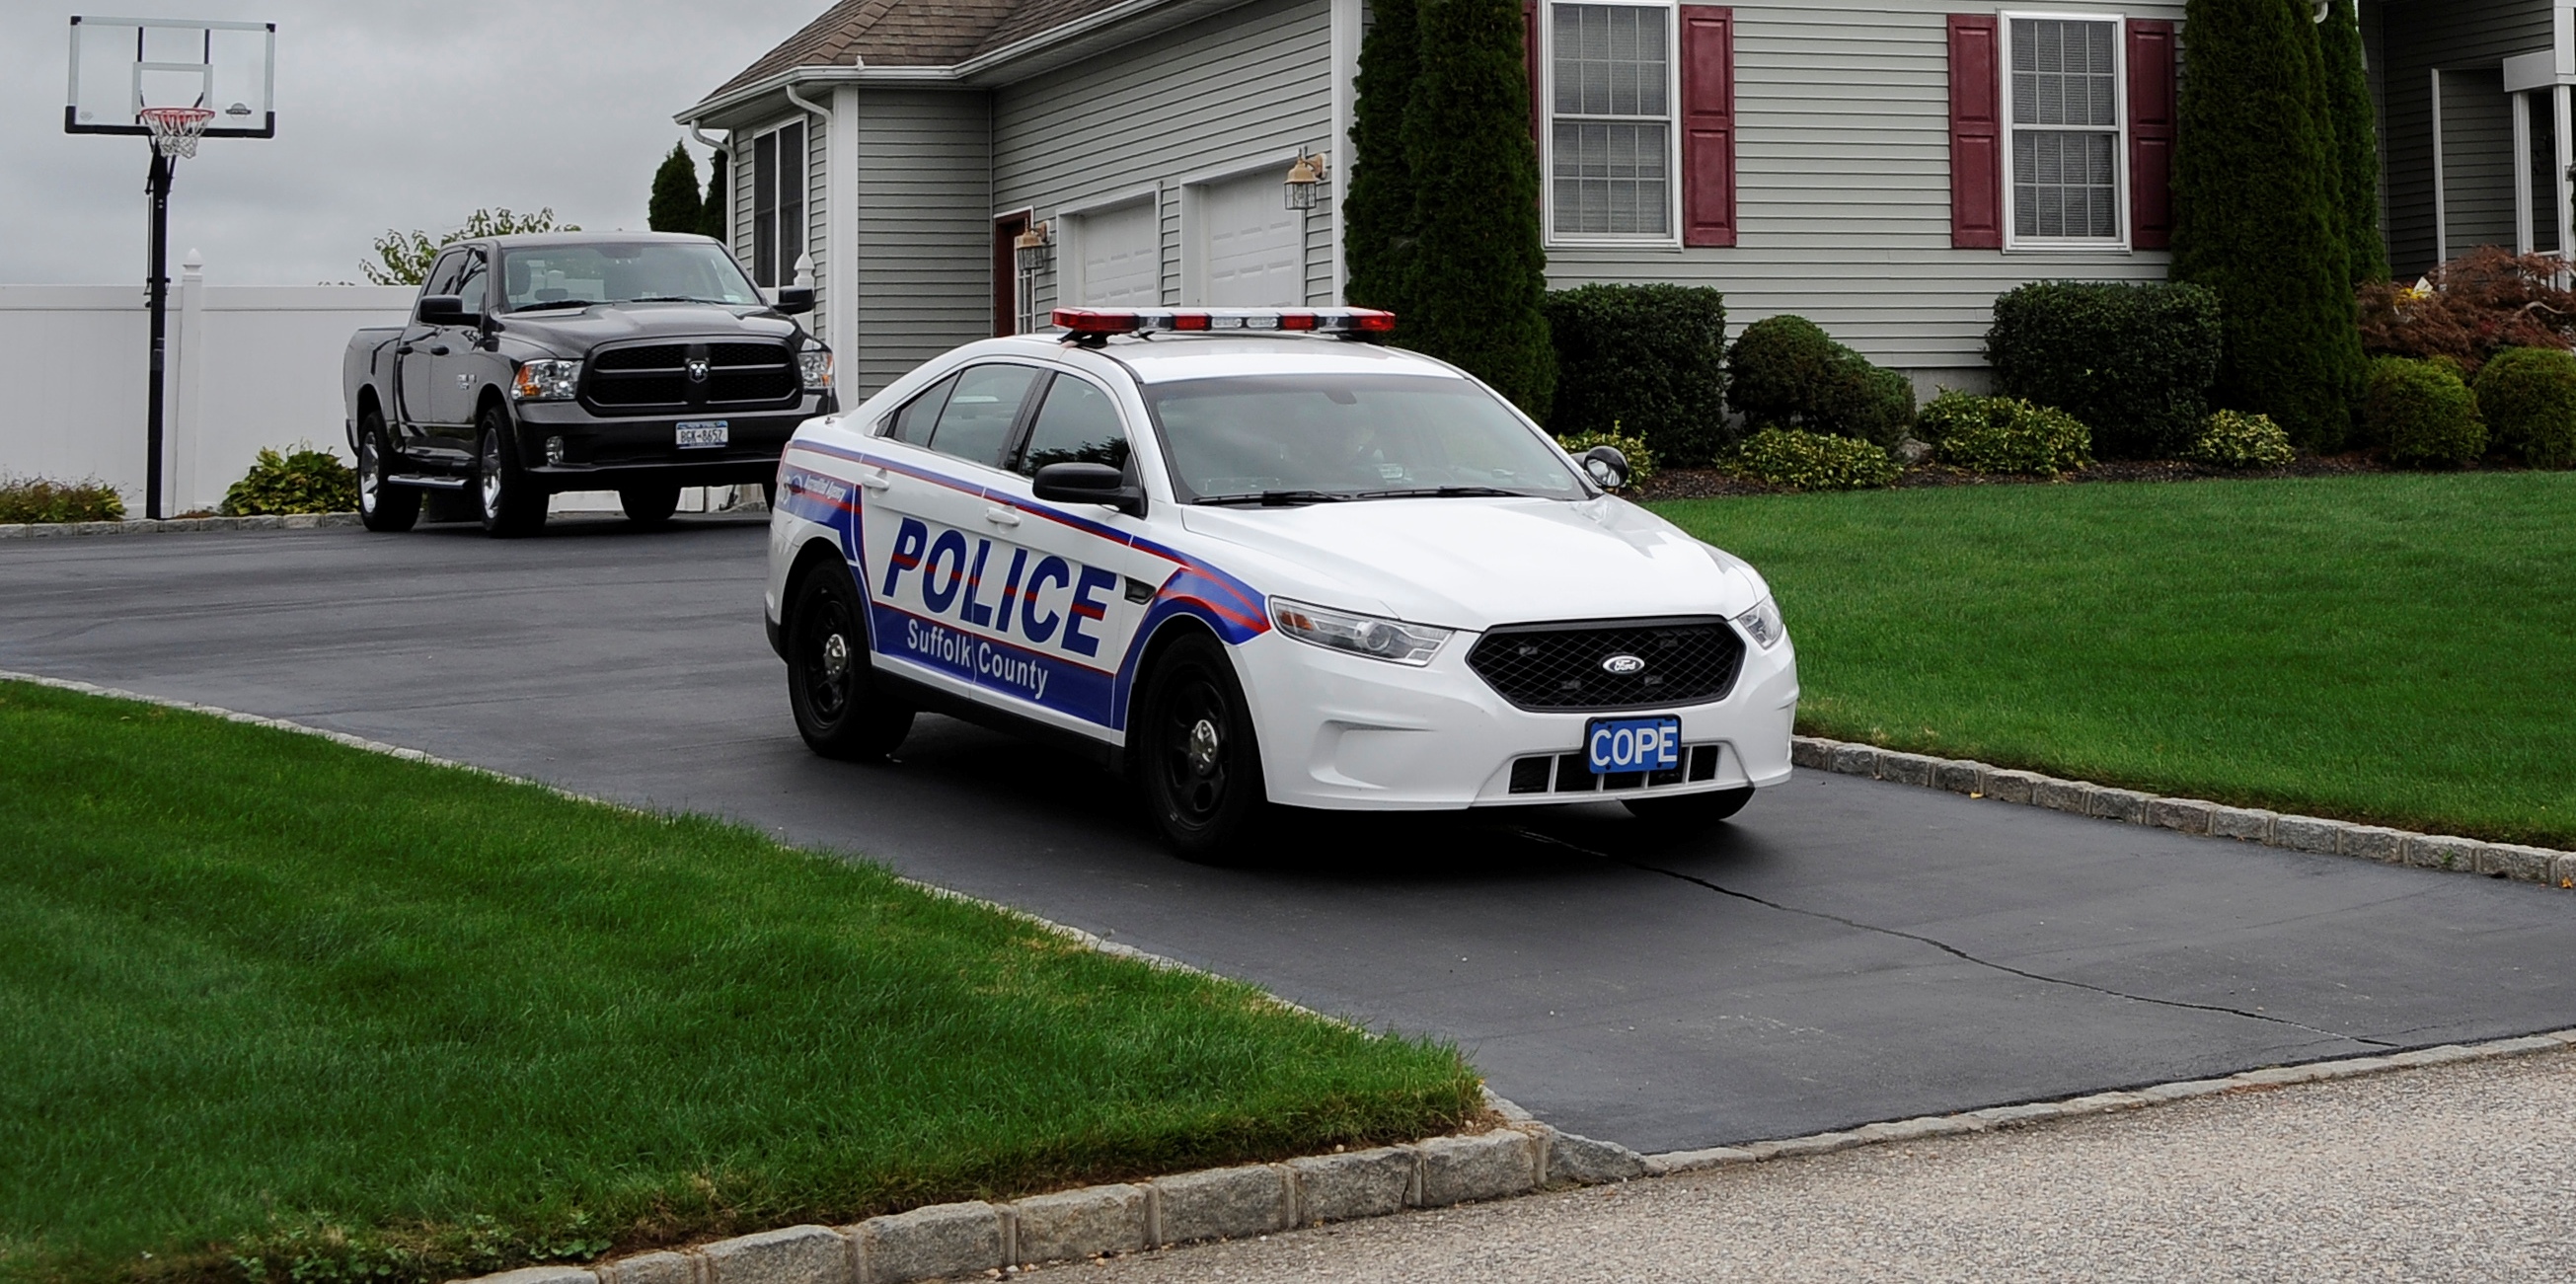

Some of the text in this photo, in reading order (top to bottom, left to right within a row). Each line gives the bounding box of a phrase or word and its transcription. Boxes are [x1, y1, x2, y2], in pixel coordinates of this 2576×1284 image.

[881, 516, 1118, 658] POLICE
[907, 618, 1048, 700] Suffolk County
[1614, 659, 1636, 671] Ford
[1589, 725, 1678, 767] COPE
